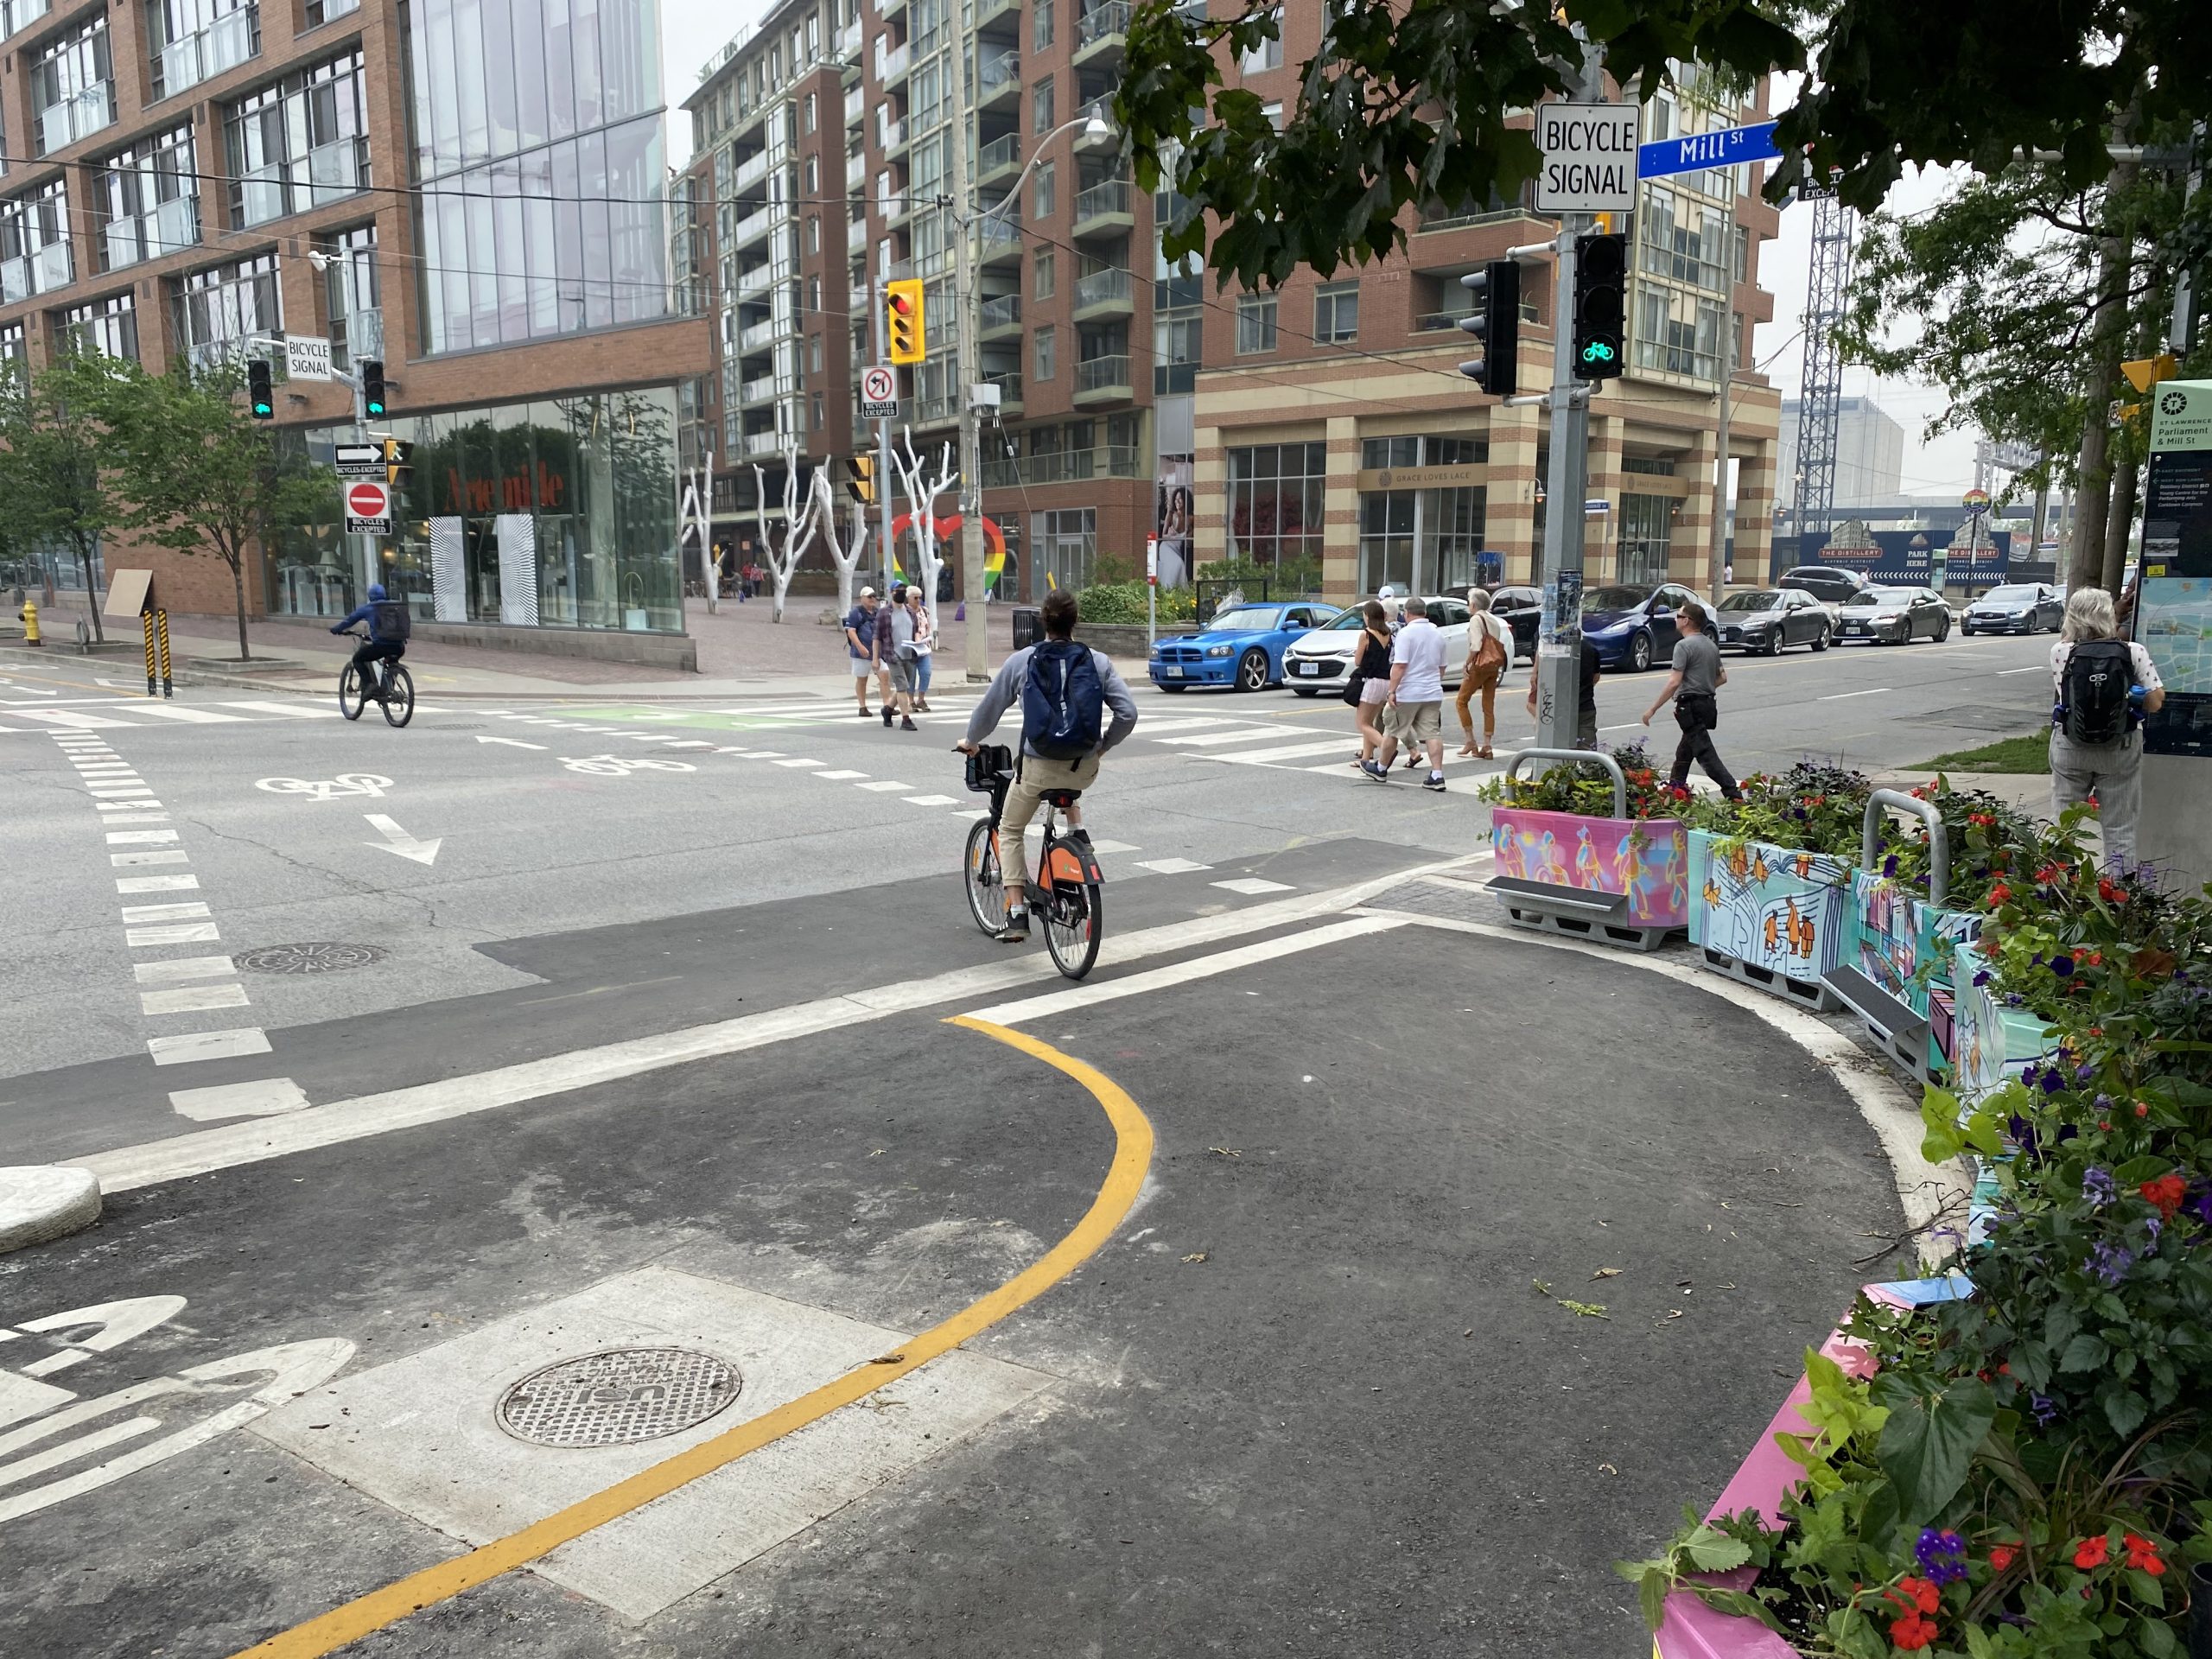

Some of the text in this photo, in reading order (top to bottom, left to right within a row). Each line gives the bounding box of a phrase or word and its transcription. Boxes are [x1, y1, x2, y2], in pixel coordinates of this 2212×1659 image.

[1547, 120, 1634, 152] BICYCLE
[1680, 131, 1744, 164] Mill St
[1548, 163, 1628, 194] SIGNAL
[289, 341, 328, 358] BICYCLE
[292, 359, 328, 375] SIGNAL
[2158, 427, 2209, 435] Parliament
[2157, 437, 2164, 446] &
[2166, 436, 2183, 445] Mill
[1396, 474, 1422, 482] GRACE
[1424, 473, 1447, 481] LOVES
[587, 1363, 672, 1377] TRAFFIC
